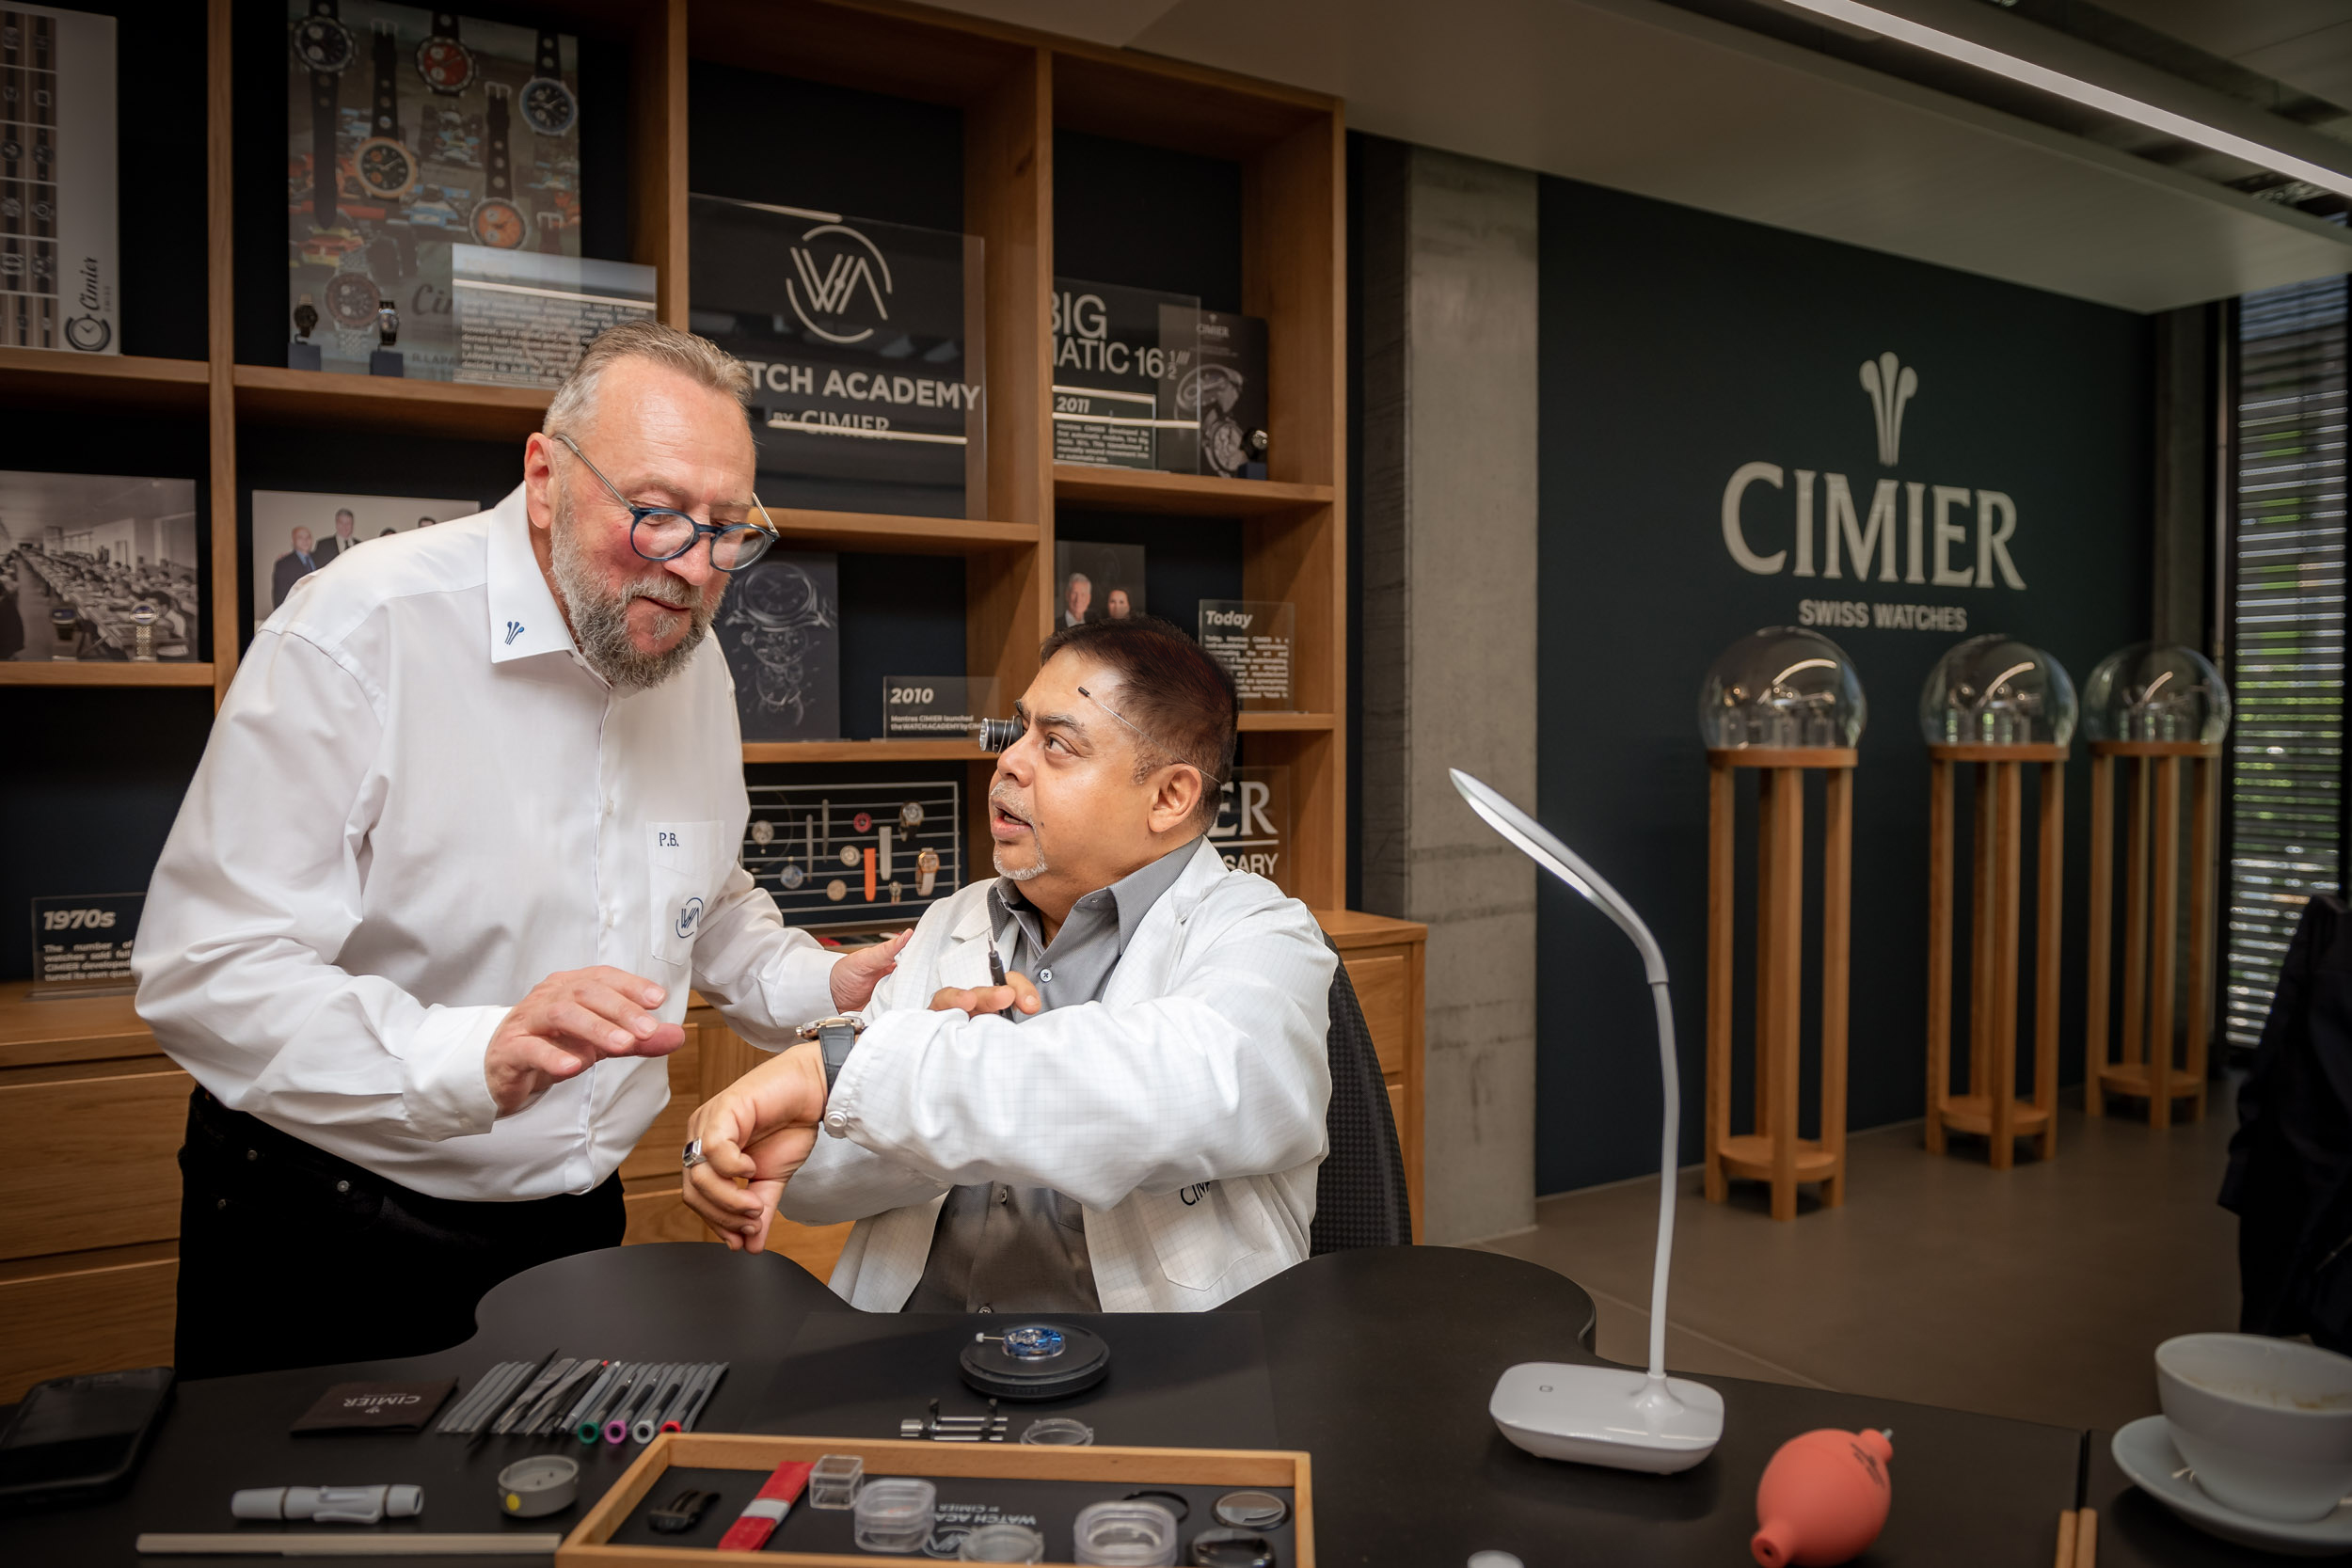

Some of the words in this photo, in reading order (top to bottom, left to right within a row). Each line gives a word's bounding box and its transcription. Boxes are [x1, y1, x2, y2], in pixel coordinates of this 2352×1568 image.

[78, 256, 100, 310] Cimier
[746, 360, 814, 395] TCH
[821, 369, 981, 411] ACADEMY
[1056, 395, 1091, 414] 2011
[1721, 461, 2027, 591] CIMIER
[1205, 610, 1253, 629] Today
[1798, 598, 1870, 629] SWISS
[1872, 602, 1968, 632] WATCHES
[890, 687, 934, 705] 2010
[659, 832, 679, 847] P.B.
[43, 909, 116, 930] 1970s
[342, 1396, 421, 1407] CIMIER
